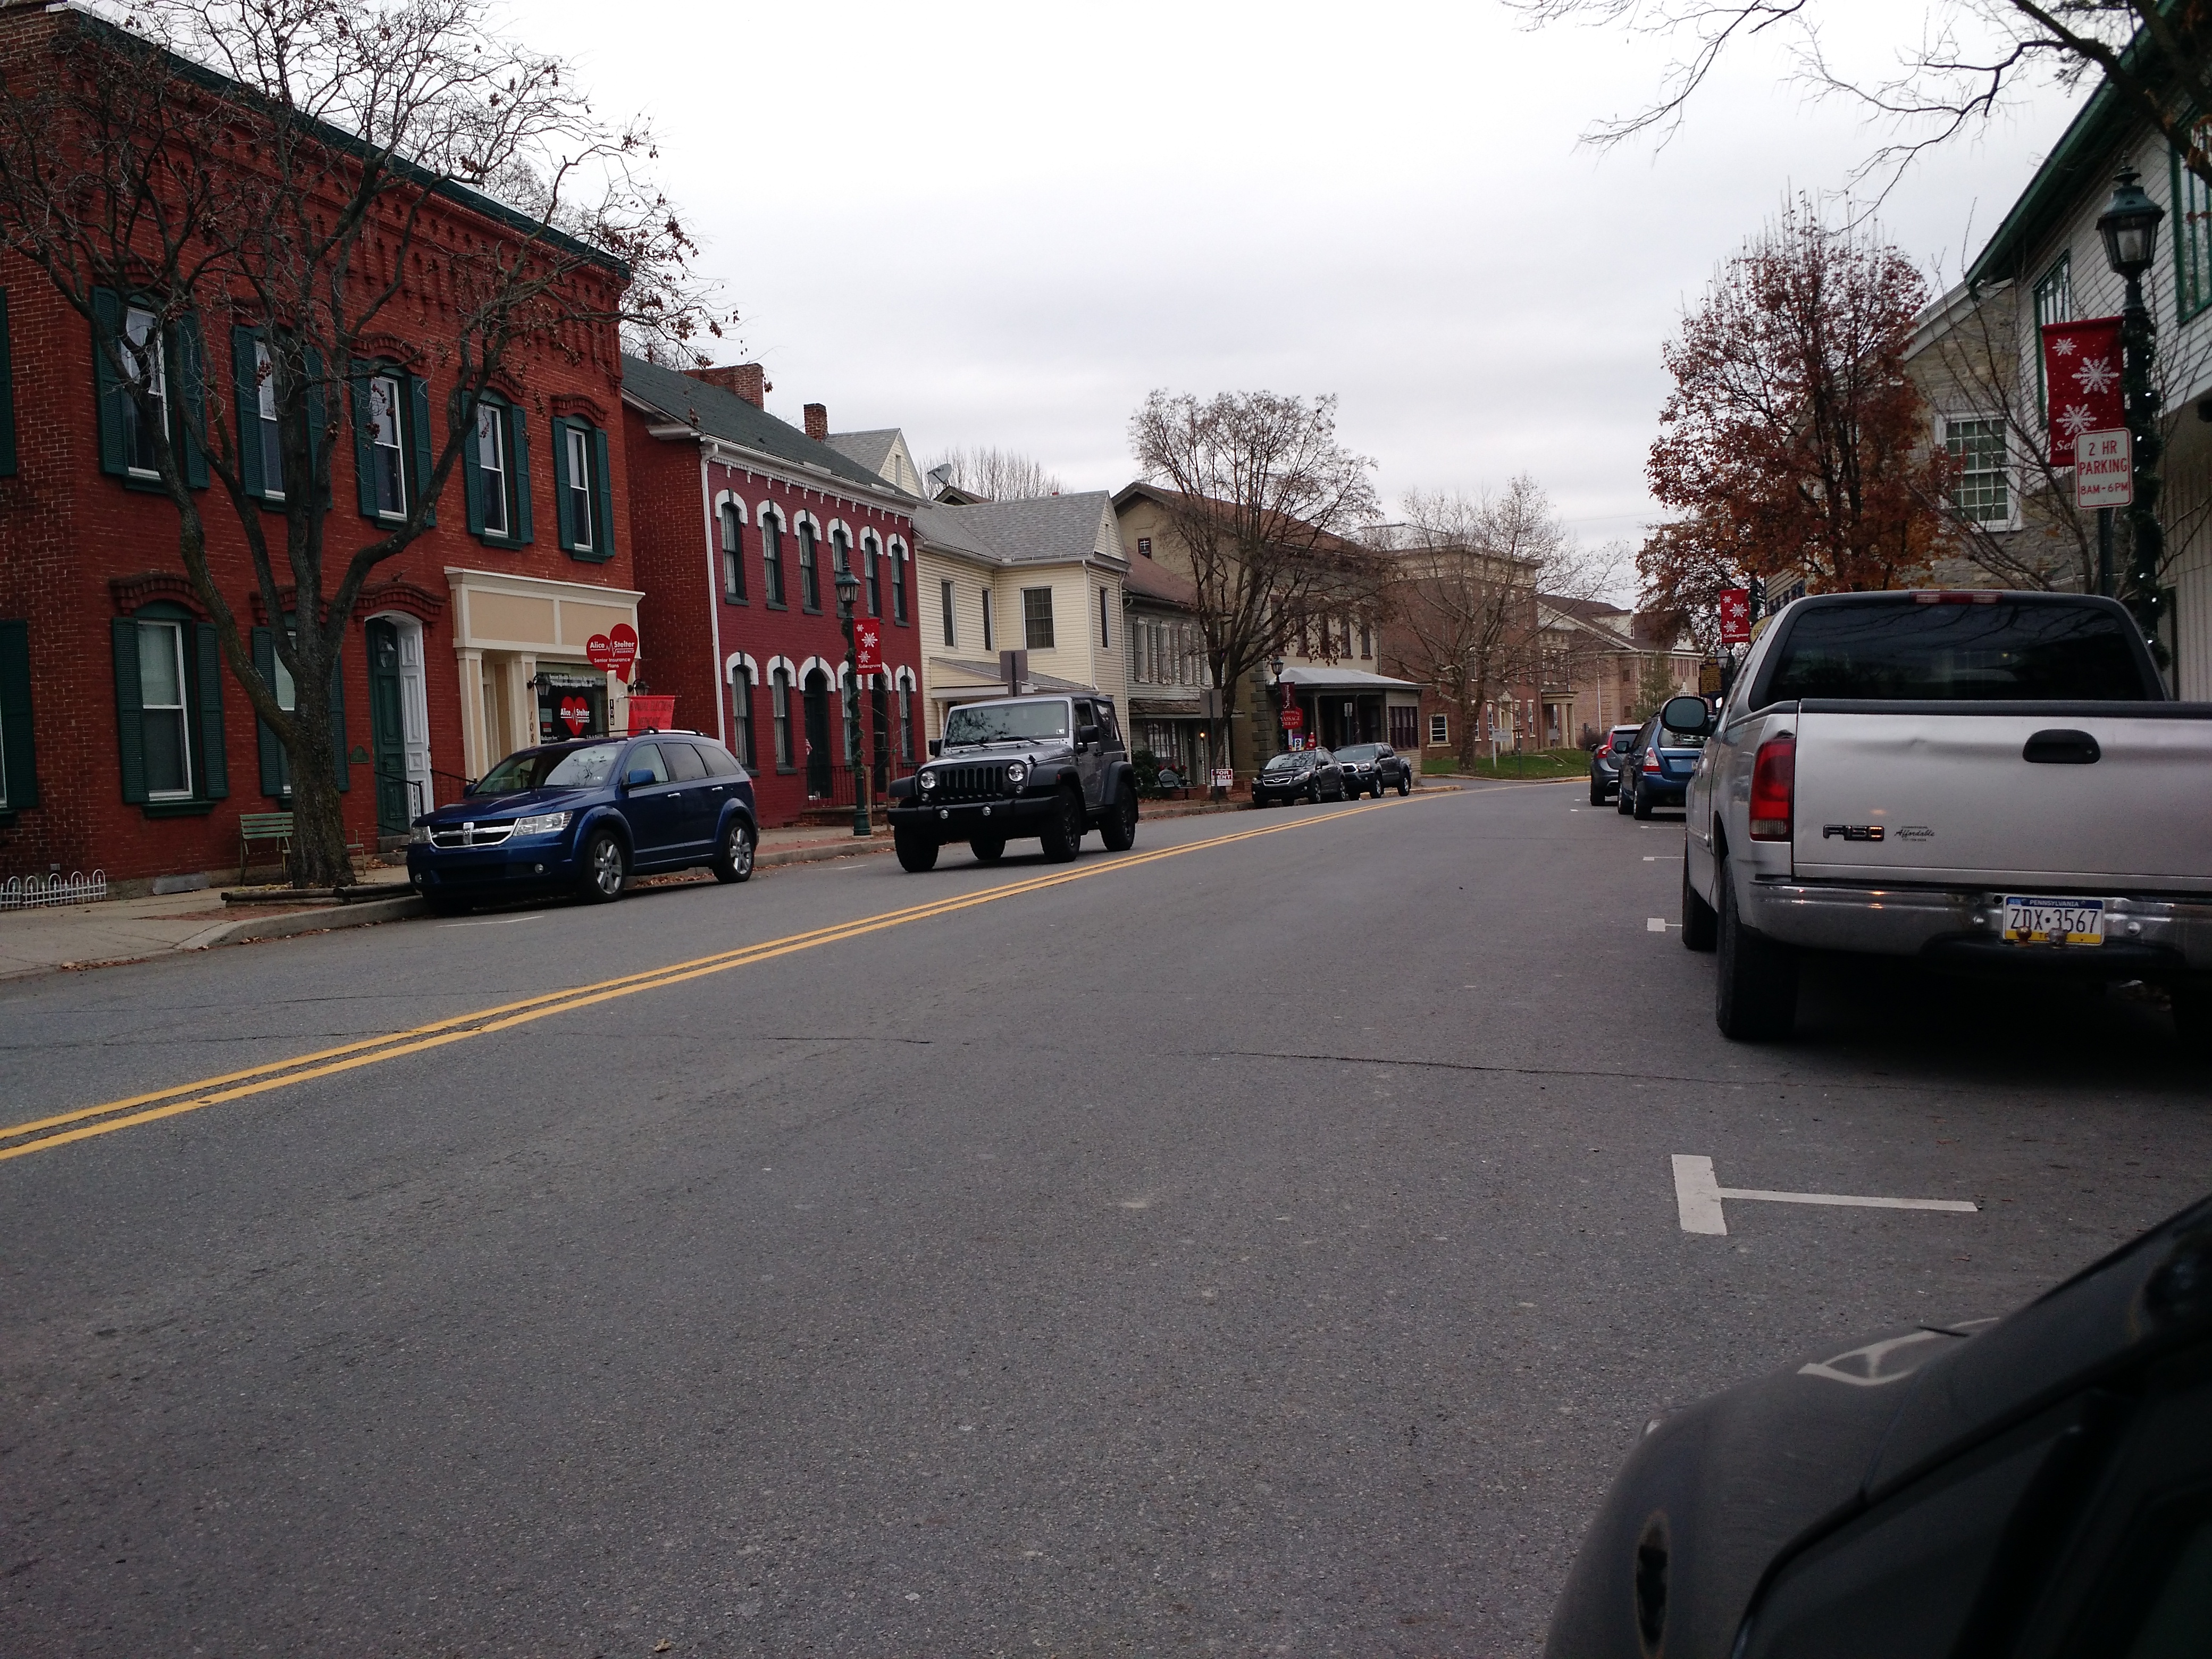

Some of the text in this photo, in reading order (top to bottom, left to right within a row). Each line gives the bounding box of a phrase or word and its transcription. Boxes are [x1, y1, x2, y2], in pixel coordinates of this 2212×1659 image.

[2089, 440, 2117, 456] 2 HR
[2079, 458, 2127, 475] PARKING
[1894, 829, 1936, 838] Affordable
